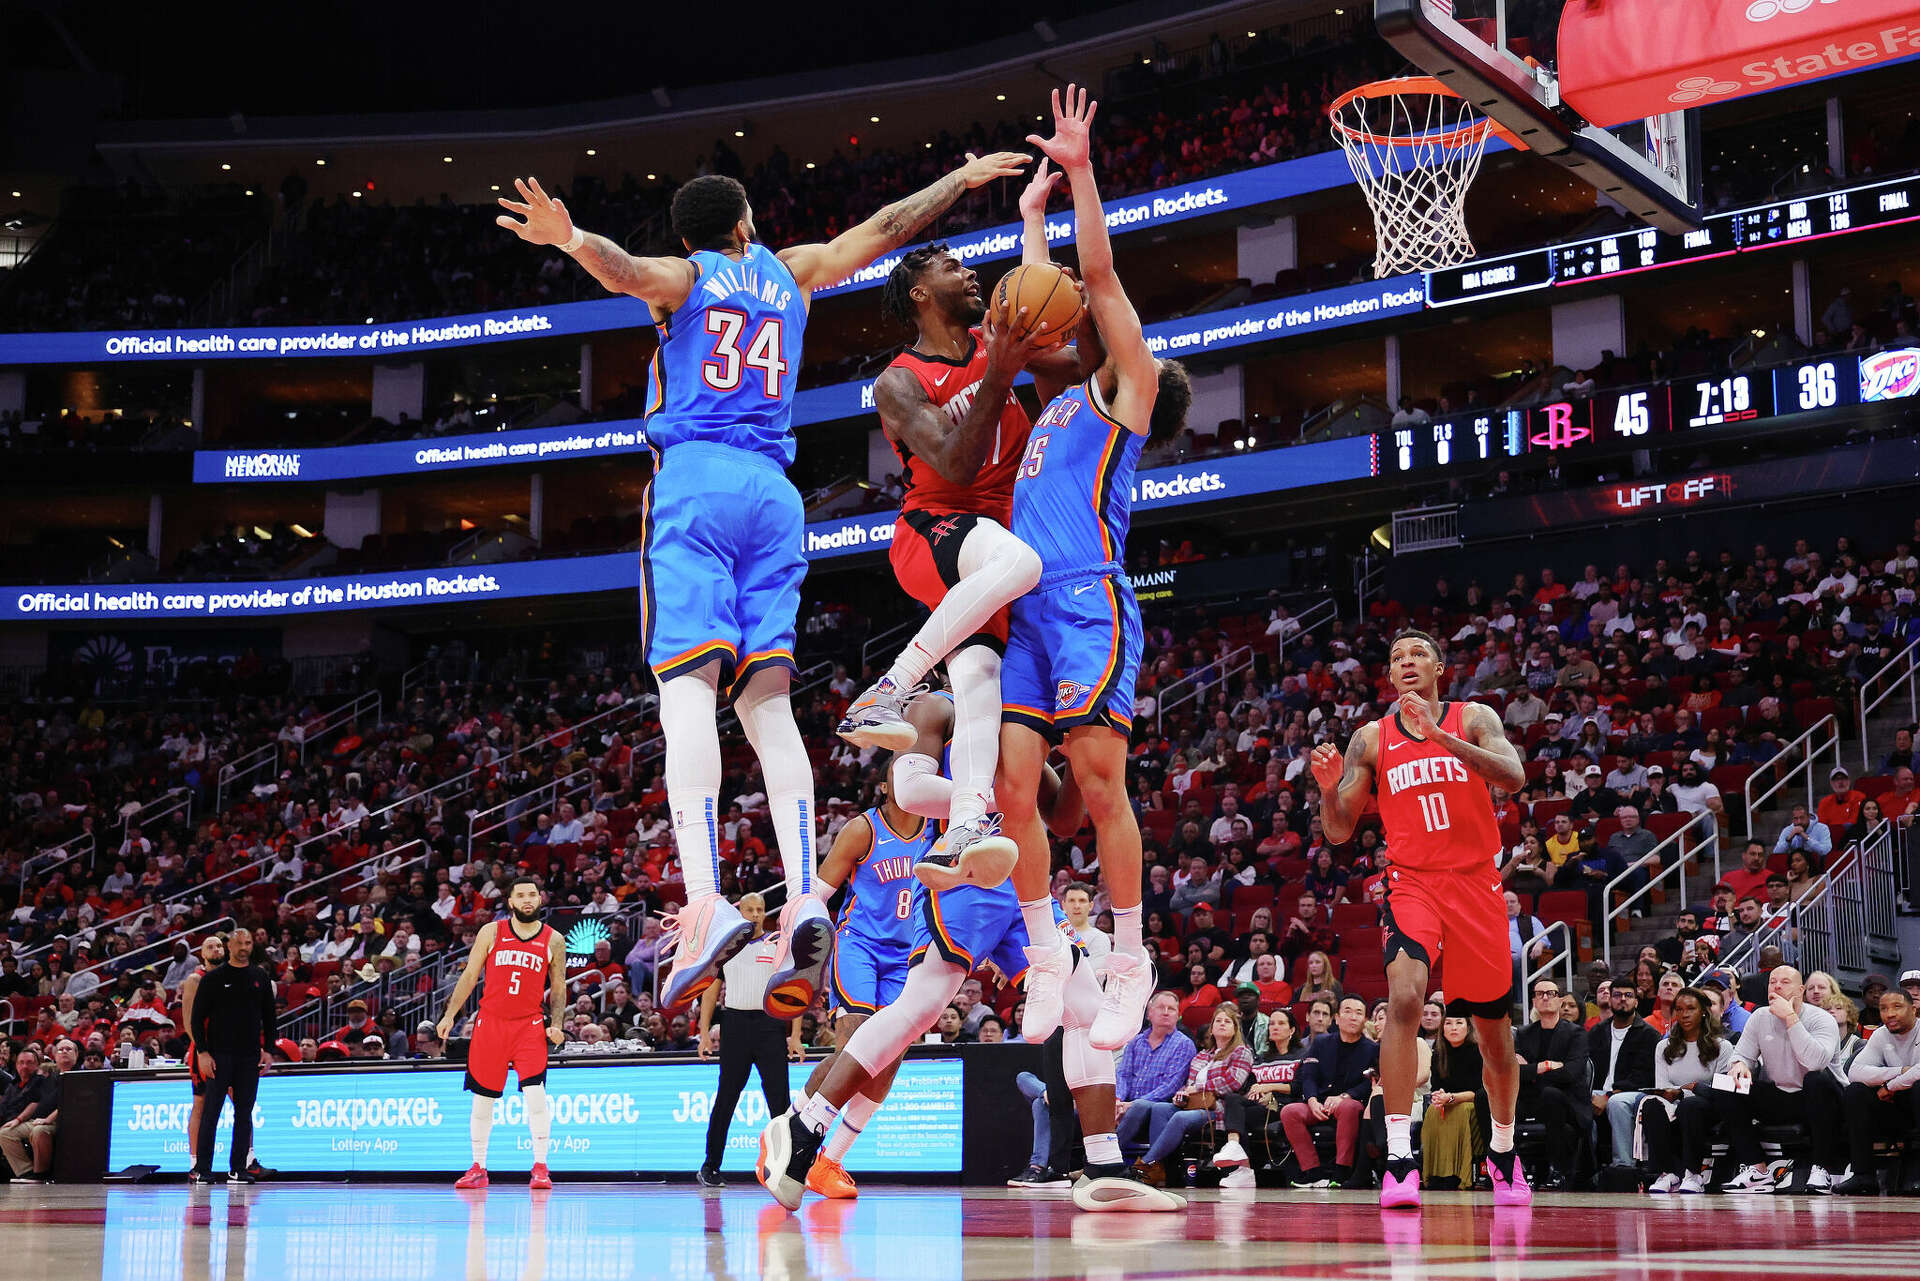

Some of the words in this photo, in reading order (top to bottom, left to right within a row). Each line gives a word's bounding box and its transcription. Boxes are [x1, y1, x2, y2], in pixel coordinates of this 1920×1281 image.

[1742, 41, 1878, 86] State
[1152, 187, 1228, 218] Rockets.
[1828, 194, 1848, 213] 121
[1879, 191, 1909, 212] FINAL
[1684, 228, 1712, 249] FINAL
[1787, 219, 1812, 239] MEM
[702, 264, 792, 311] WILLIAMS
[106, 336, 172, 354] Official
[176, 335, 235, 352] health
[238, 337, 277, 351] care
[280, 333, 357, 354] provider
[359, 331, 380, 349] of
[380, 331, 409, 347] the
[411, 324, 482, 344] Houston
[484, 315, 552, 336] Rockets.
[1170, 330, 1201, 349] care
[1203, 318, 1265, 347] provider
[1267, 312, 1285, 330] of
[1285, 308, 1312, 326] the
[1314, 296, 1380, 322] Houston
[702, 307, 789, 400] 34
[1614, 392, 1649, 436] 45
[1696, 376, 1750, 417] 7:13
[1798, 362, 1837, 410] 36
[1395, 430, 1413, 447] TOL
[1433, 423, 1452, 441] FLS
[1474, 417, 1489, 435] CC
[1477, 434, 1487, 459] 1
[226, 454, 300, 467] MEMORIAL
[415, 446, 463, 464] Official
[464, 442, 507, 460] health
[509, 443, 537, 455] care
[539, 436, 595, 456] provider
[595, 433, 612, 447] of
[612, 432, 635, 446] the
[1015, 433, 1051, 482] 25
[225, 464, 300, 477] HERMANN
[1141, 471, 1226, 501] Rockets.
[808, 524, 866, 552] health
[869, 523, 896, 542] car
[18, 593, 89, 612] Official
[94, 592, 159, 611] health
[162, 595, 205, 609] care
[208, 589, 289, 613] provider
[291, 586, 313, 606] of
[313, 585, 343, 604] the
[347, 581, 423, 602] Houston
[426, 574, 500, 596] Rockets.
[1126, 570, 1177, 588] RMANN
[1386, 756, 1468, 795] ROCKETS
[1418, 792, 1450, 832] 10
[872, 856, 912, 885] THUN
[896, 888, 912, 919] 8
[495, 950, 544, 973] ROCKETS
[508, 971, 521, 995] 5
[164, 1140, 190, 1152] Lotte
[332, 1138, 371, 1154] Lottery
[374, 1138, 398, 1154] App
[564, 1135, 591, 1152] App
